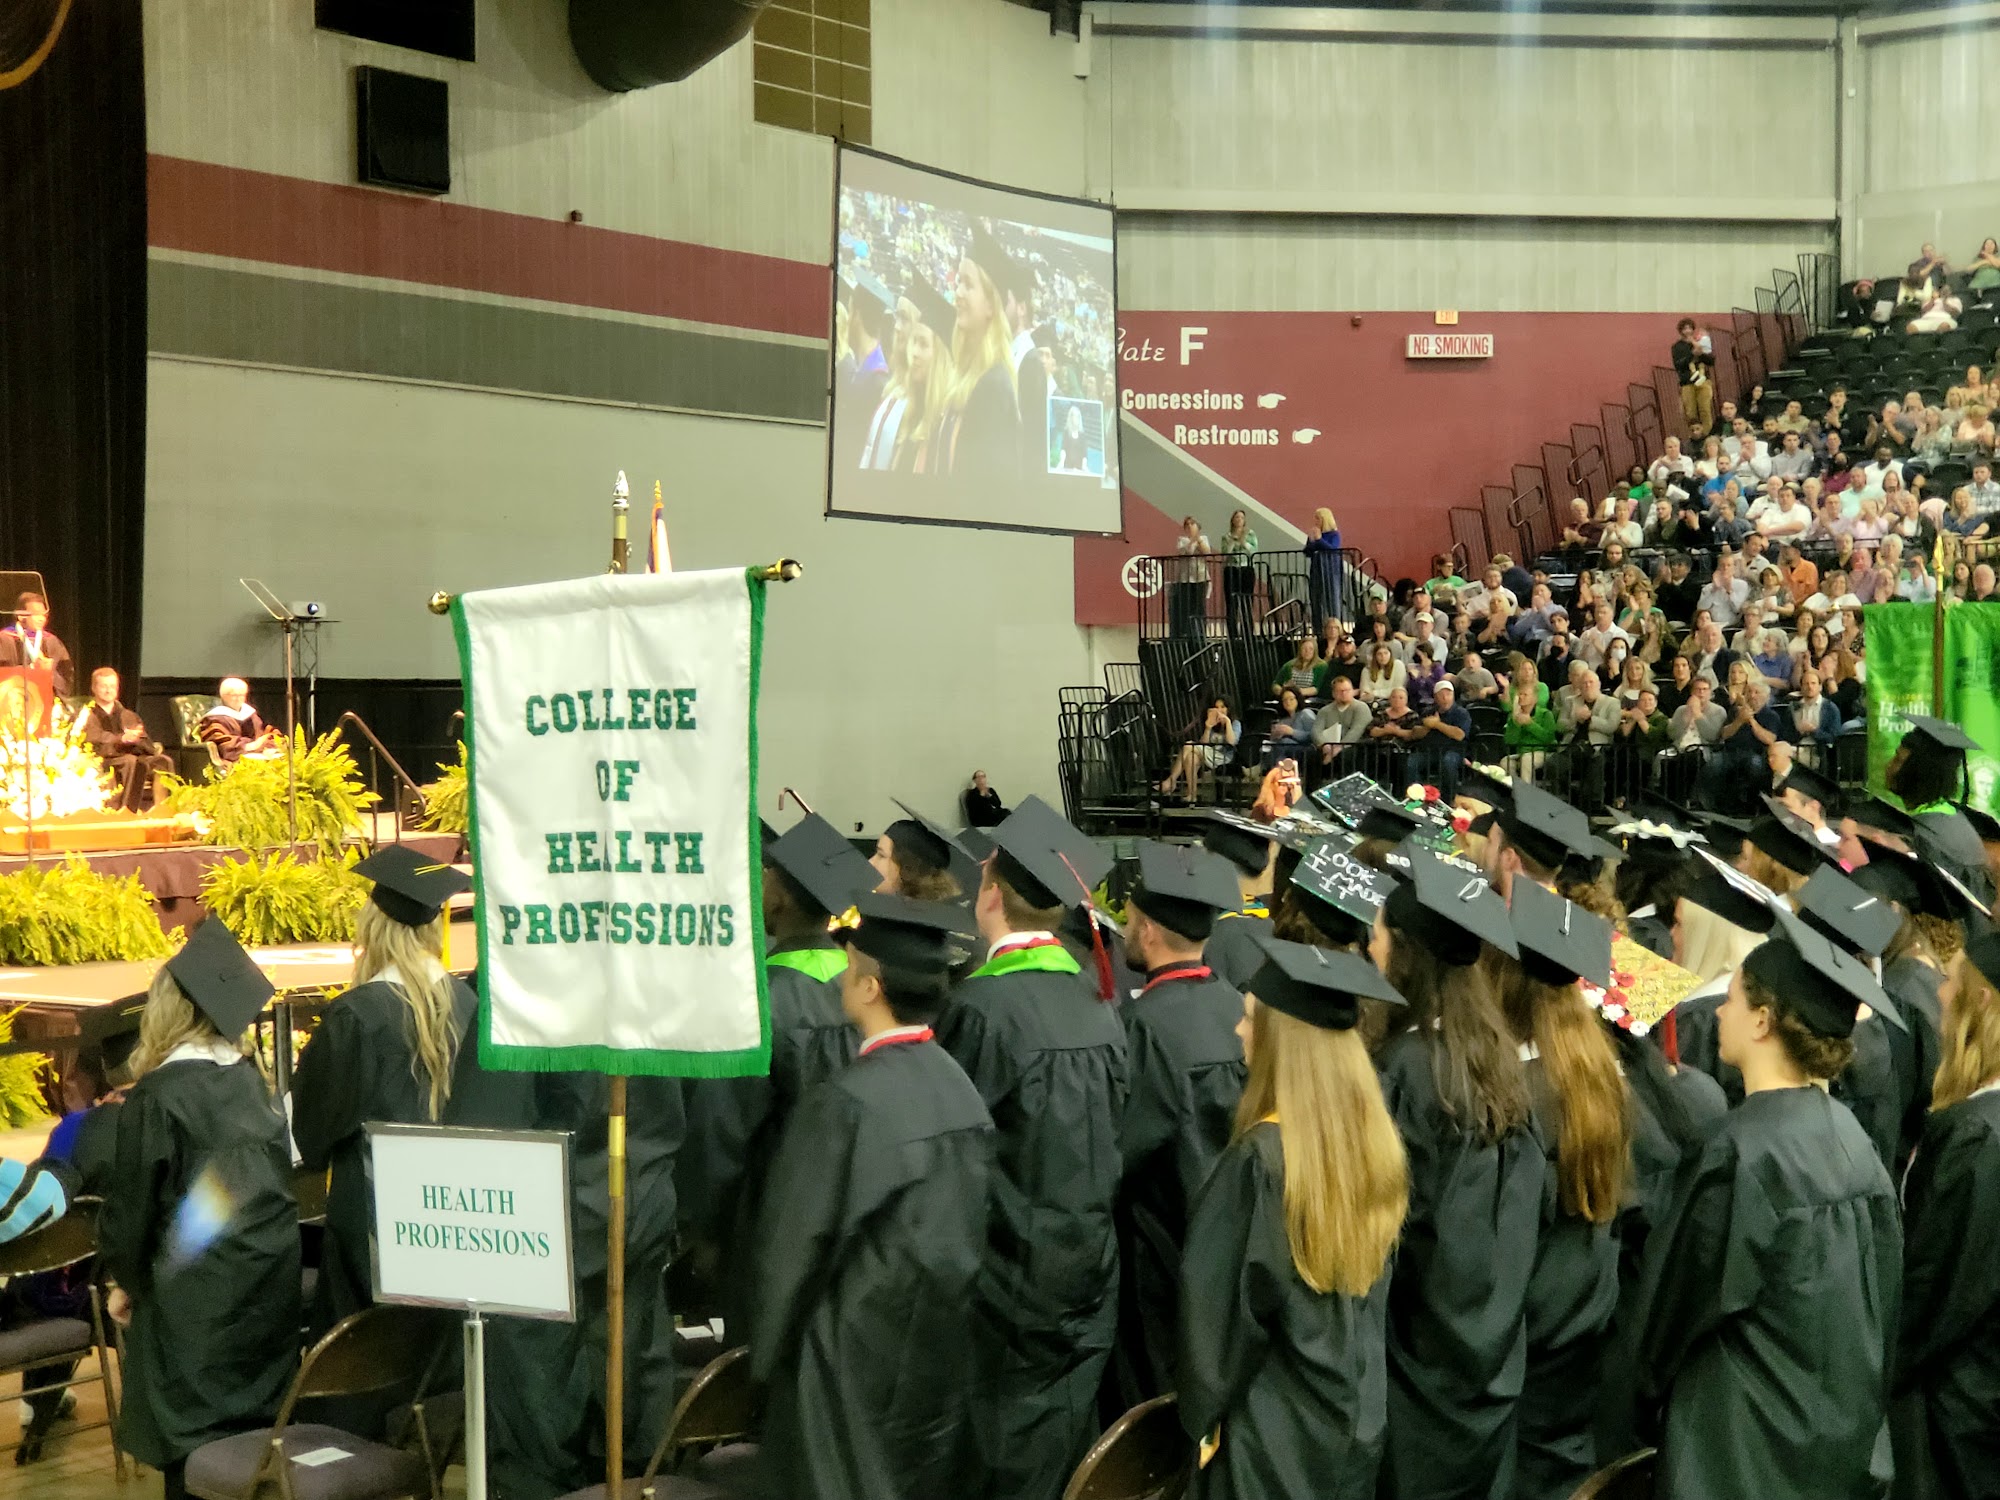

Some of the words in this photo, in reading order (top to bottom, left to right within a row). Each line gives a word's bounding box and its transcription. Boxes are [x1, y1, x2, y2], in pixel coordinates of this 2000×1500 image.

[1440, 312, 1455, 322] EXIT
[1181, 327, 1208, 365] F
[1414, 337, 1429, 355] NO
[1435, 337, 1488, 355] SMOKING
[1122, 389, 1244, 410] Concessions
[1175, 424, 1279, 445] Restrooms
[526, 688, 697, 736] COLLEGE
[596, 760, 640, 802] OF
[545, 831, 705, 874] HEALTH
[422, 1184, 515, 1215] HEALTH
[395, 1221, 550, 1258] PROFESSIONS
